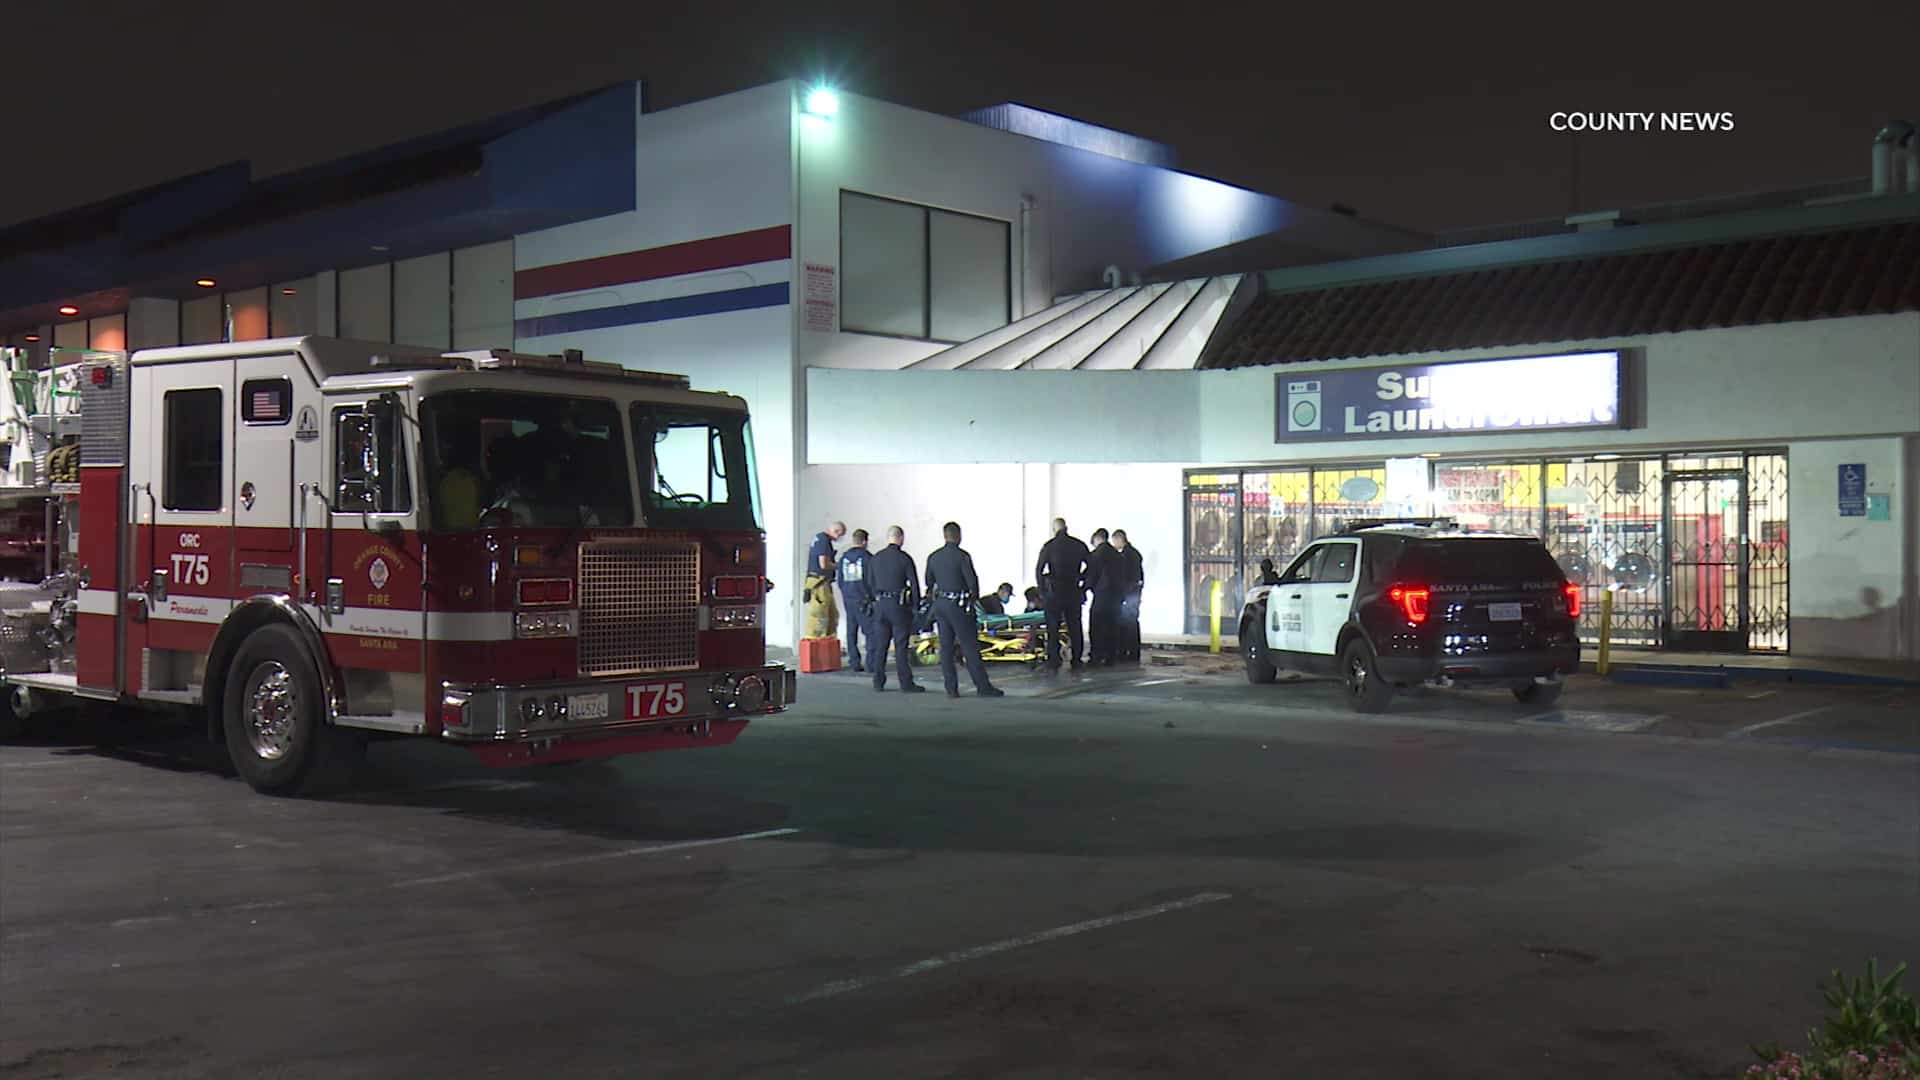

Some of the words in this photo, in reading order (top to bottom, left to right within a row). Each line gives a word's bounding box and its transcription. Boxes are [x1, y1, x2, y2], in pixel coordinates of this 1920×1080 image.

[180, 533, 201, 548] ORC
[170, 553, 209, 585] T75
[367, 594, 391, 606] FIRE
[627, 682, 684, 717] T75
